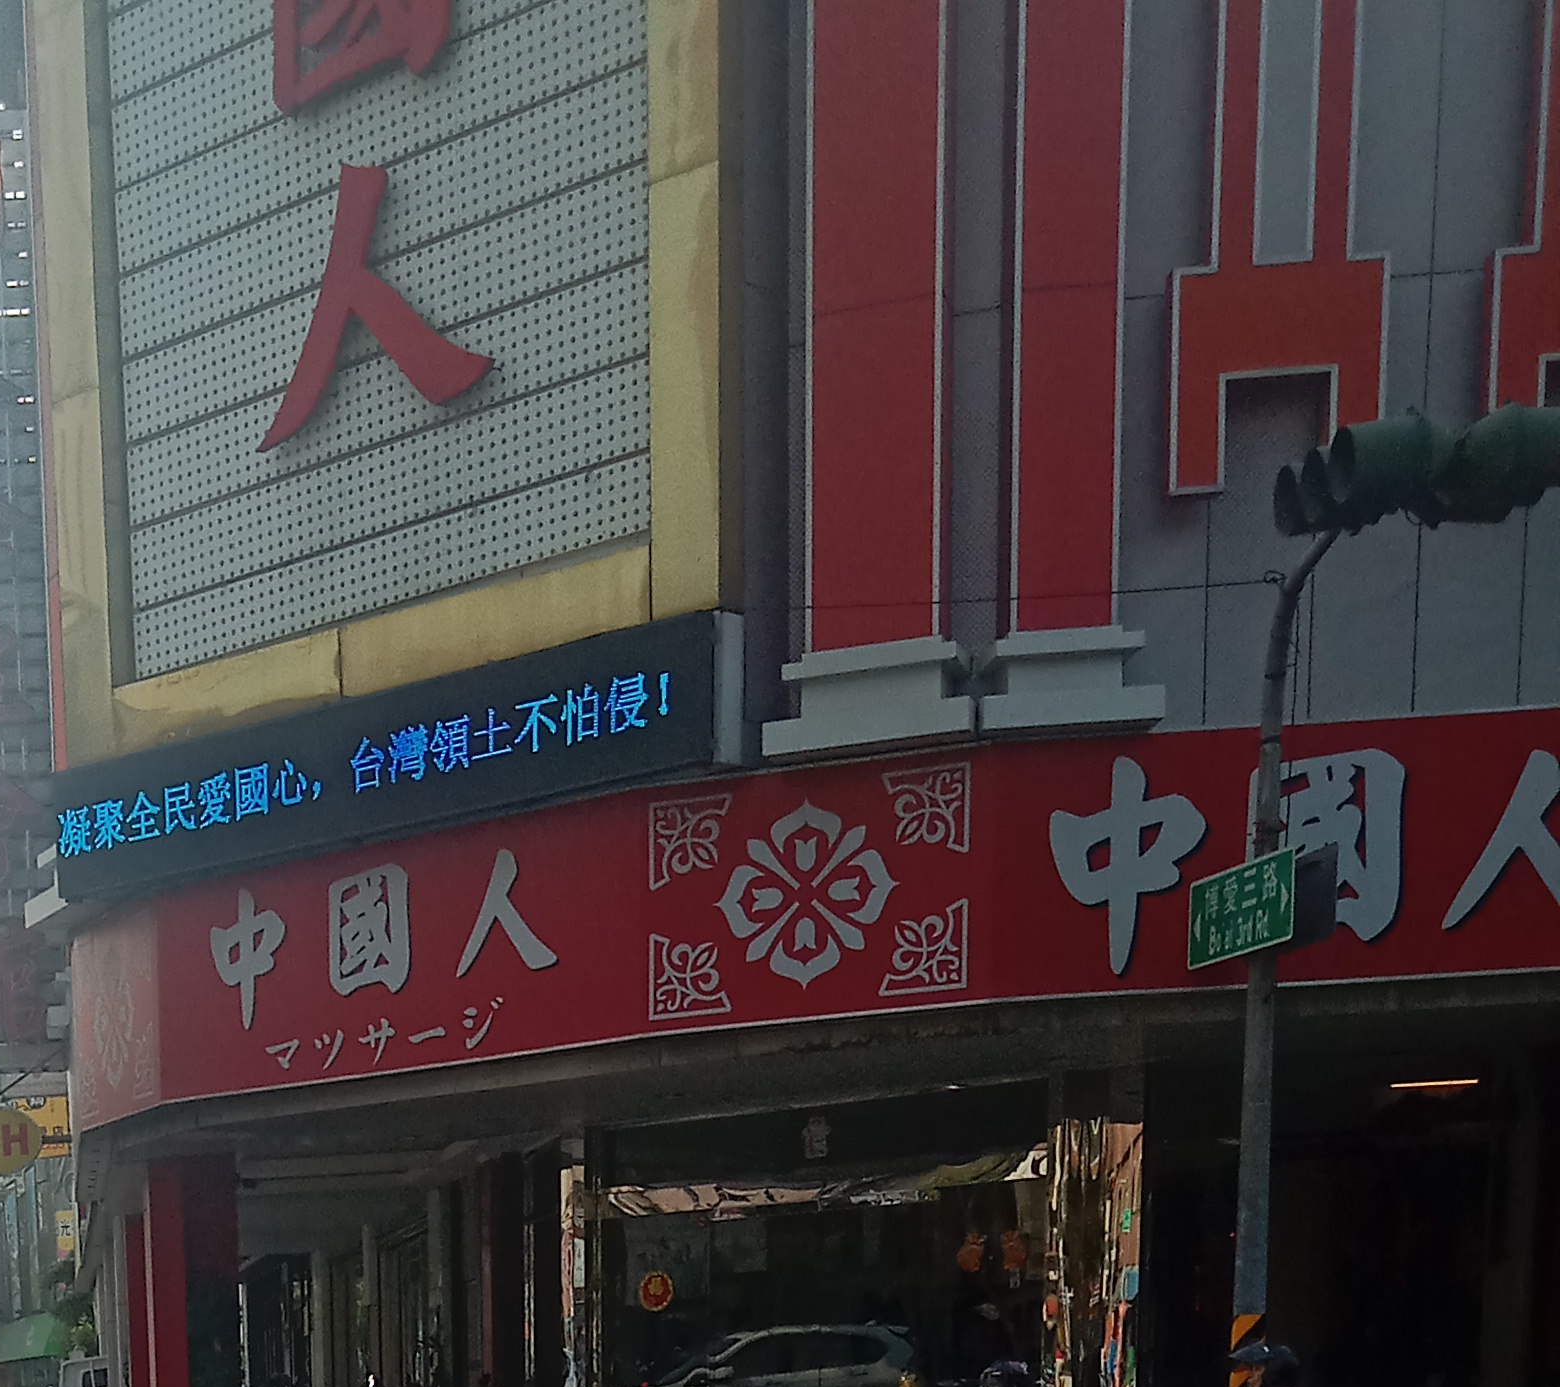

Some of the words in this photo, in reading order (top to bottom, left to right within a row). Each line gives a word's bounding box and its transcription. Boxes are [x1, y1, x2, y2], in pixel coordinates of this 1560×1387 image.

[209, 849, 559, 1030] 中國人
[1204, 861, 1278, 921] 博愛三路
